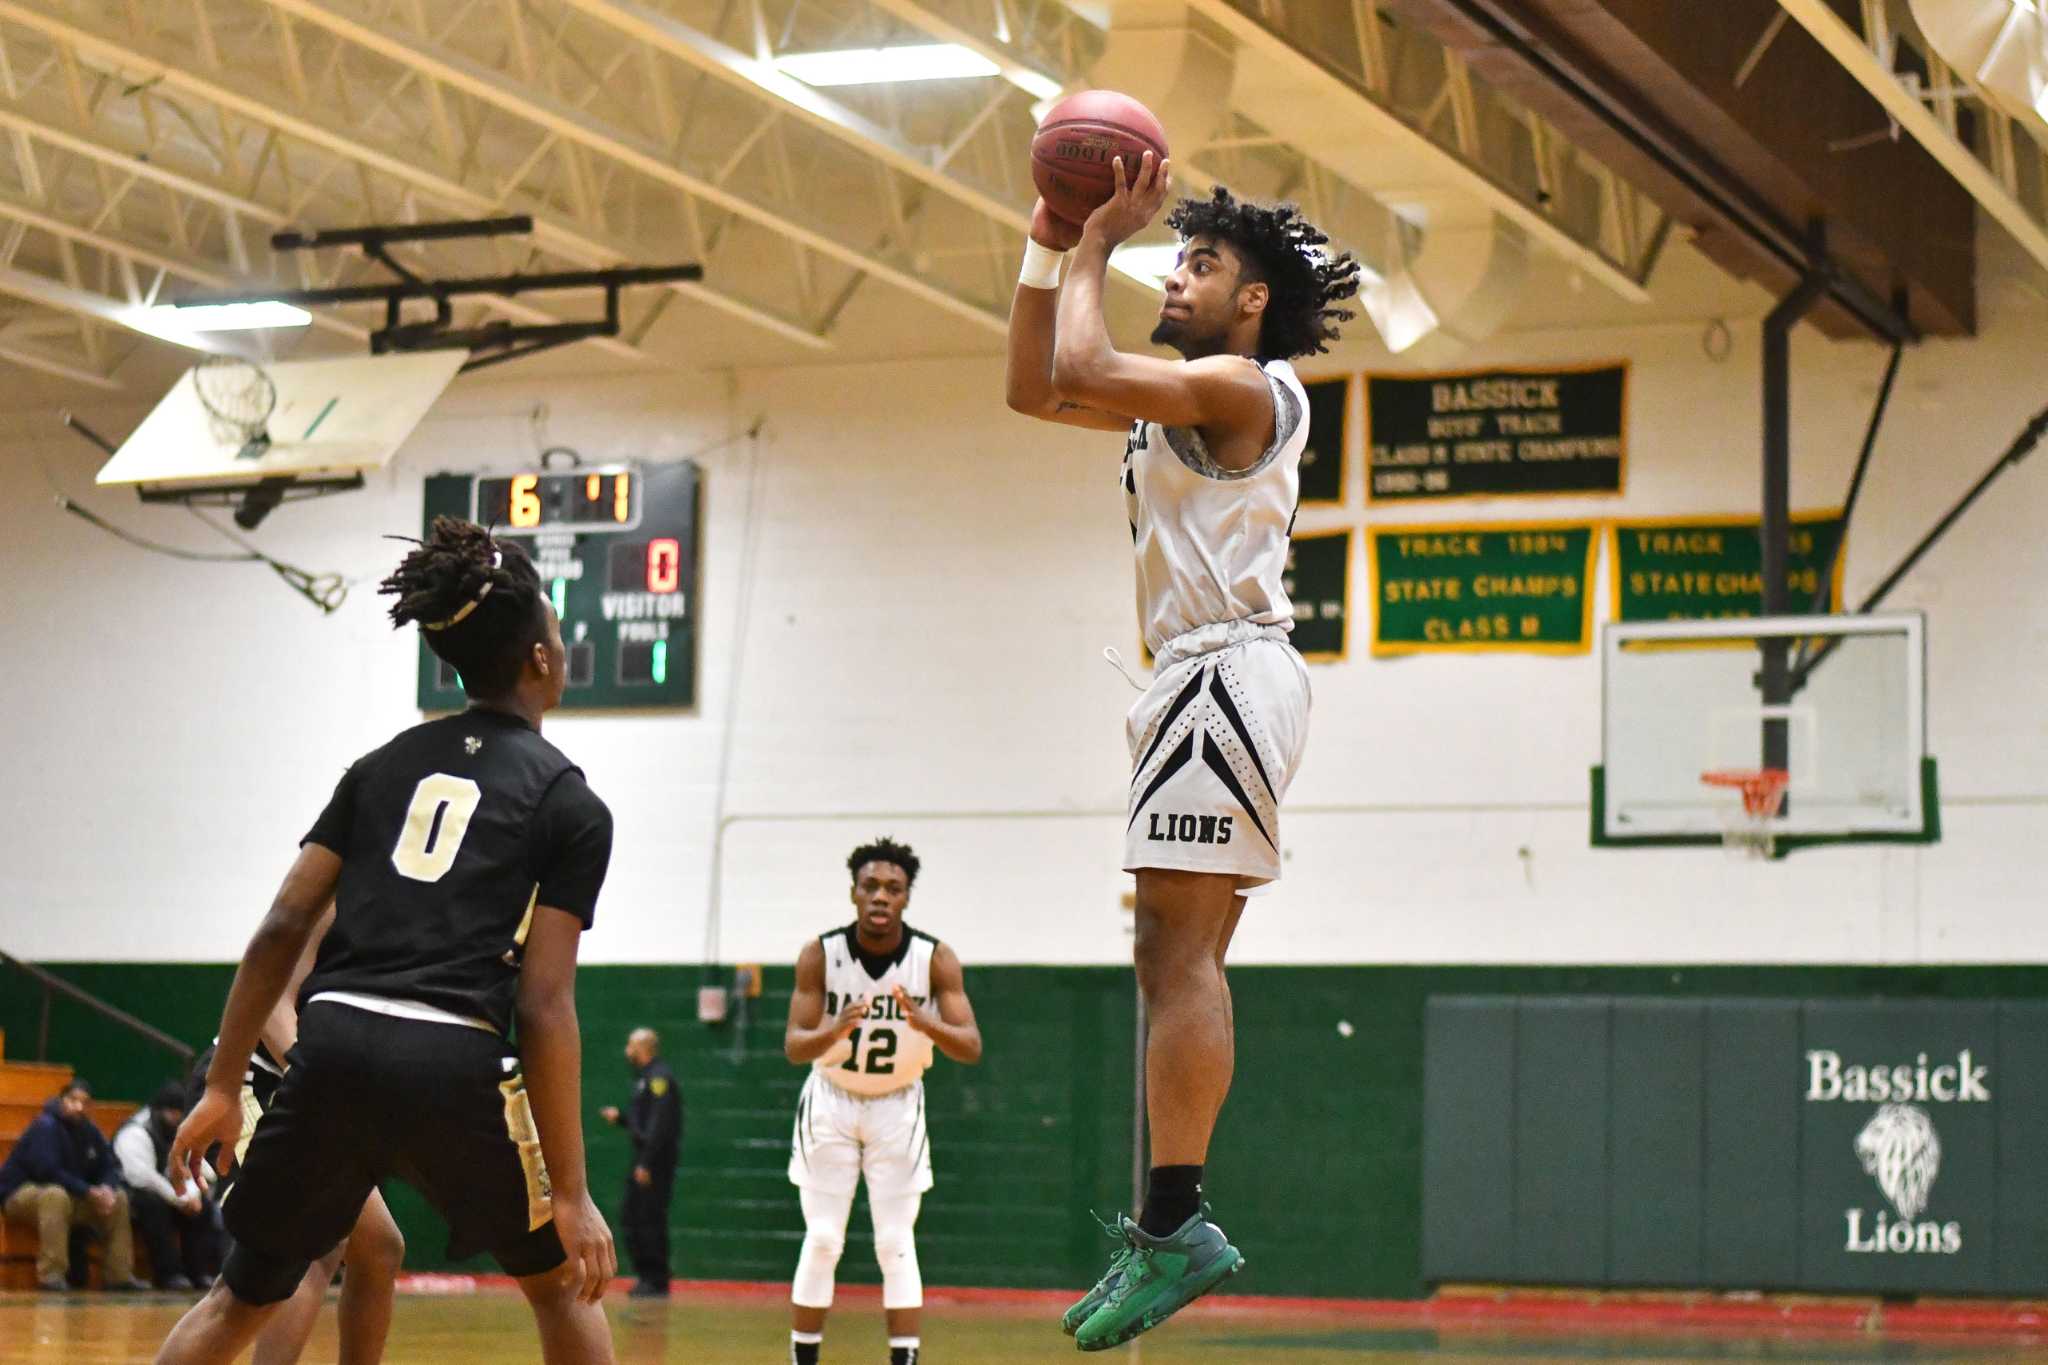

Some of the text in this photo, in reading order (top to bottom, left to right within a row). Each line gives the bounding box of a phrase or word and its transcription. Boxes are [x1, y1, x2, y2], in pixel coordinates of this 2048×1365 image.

[1432, 379, 1559, 412] BASSICK
[1496, 411, 1561, 434] TRACK
[1453, 439, 1512, 462] STATE
[510, 474, 540, 527] 6
[1399, 536, 1481, 557] TRACK
[1638, 533, 1722, 555] TRACK
[648, 538, 679, 592] 0
[1384, 574, 1577, 603] STATE CHAMPS
[1630, 570, 1818, 596] STATE CHAPS
[601, 591, 685, 620] VISITOR
[1424, 614, 1509, 642] CLASS
[651, 639, 667, 684] 1
[392, 773, 482, 883] 0
[1147, 813, 1233, 844] LIONS
[841, 1027, 897, 1074] 12
[1805, 1049, 1991, 1102] Bassick
[1844, 1208, 1963, 1254] Lions
